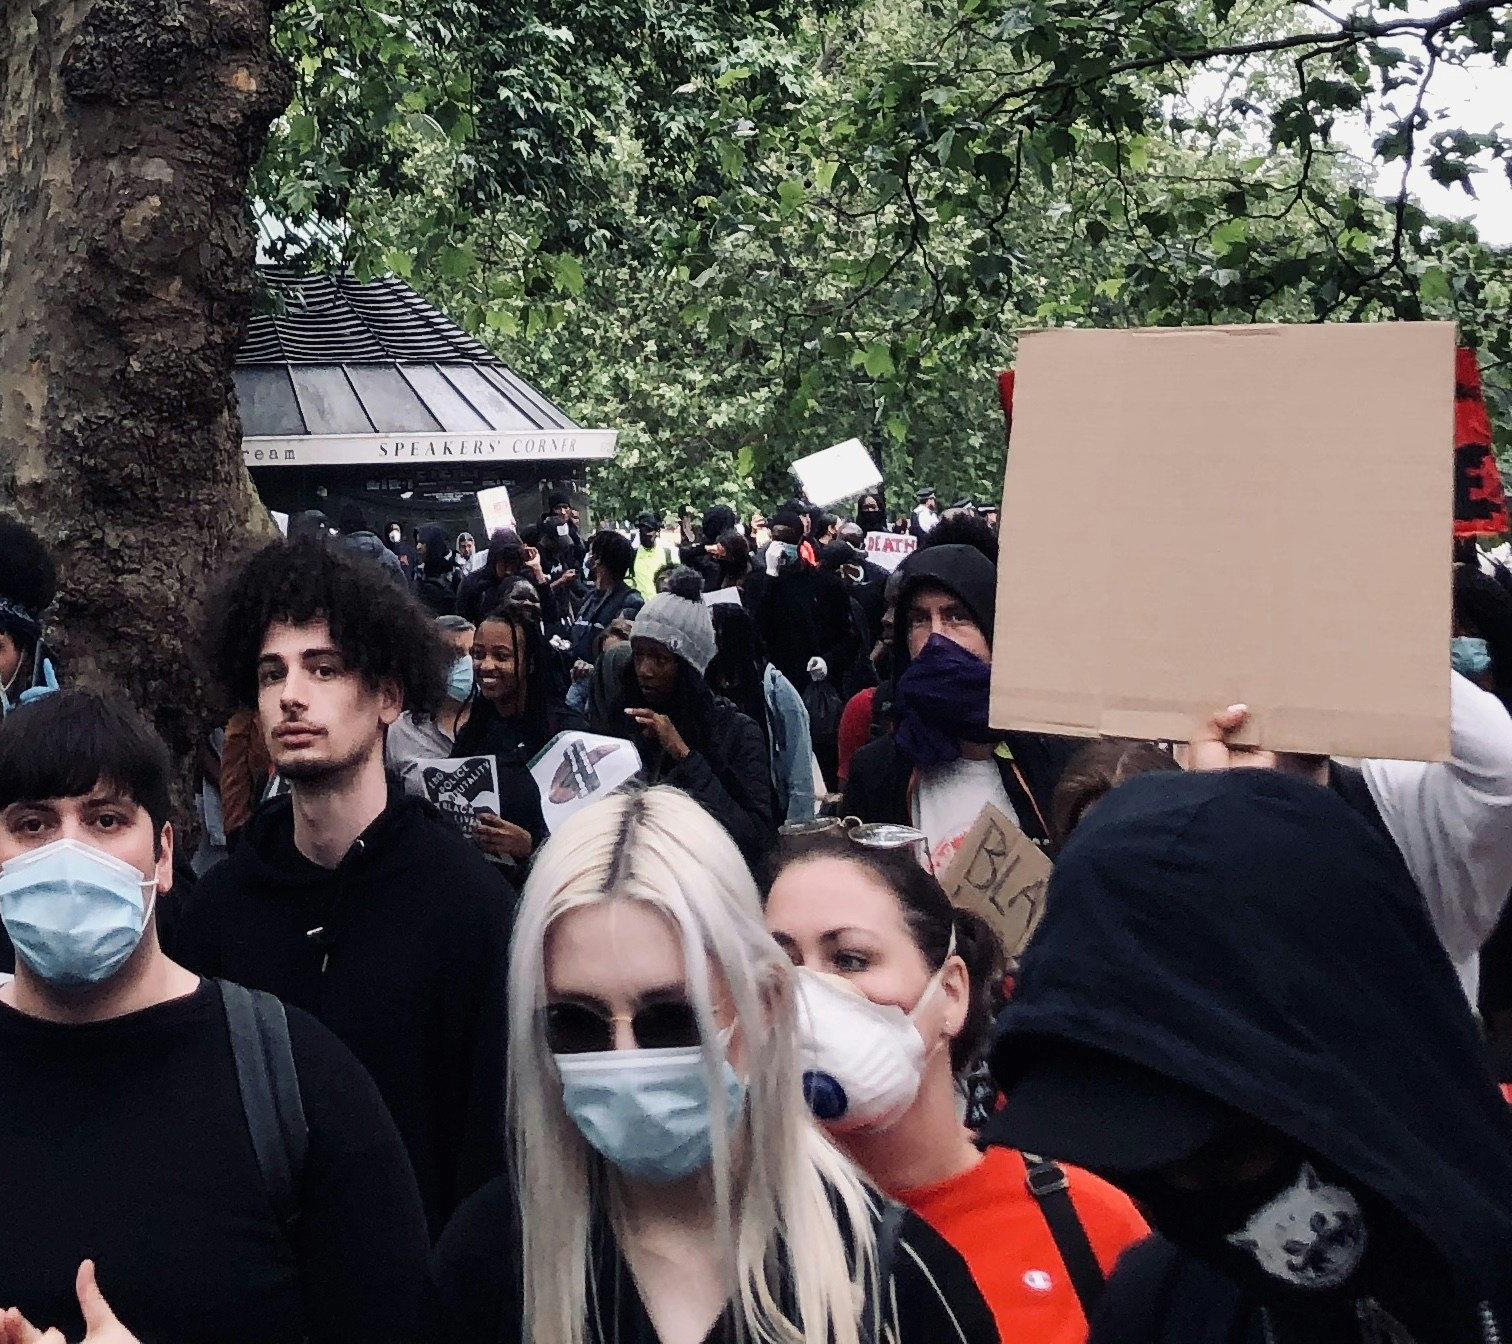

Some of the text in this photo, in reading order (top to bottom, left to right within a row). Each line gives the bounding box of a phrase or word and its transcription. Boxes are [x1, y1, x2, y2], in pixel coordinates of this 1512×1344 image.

[379, 439, 500, 457] SPEAKERS'
[512, 438, 577, 454] CORNER
[868, 536, 915, 553] DEATH
